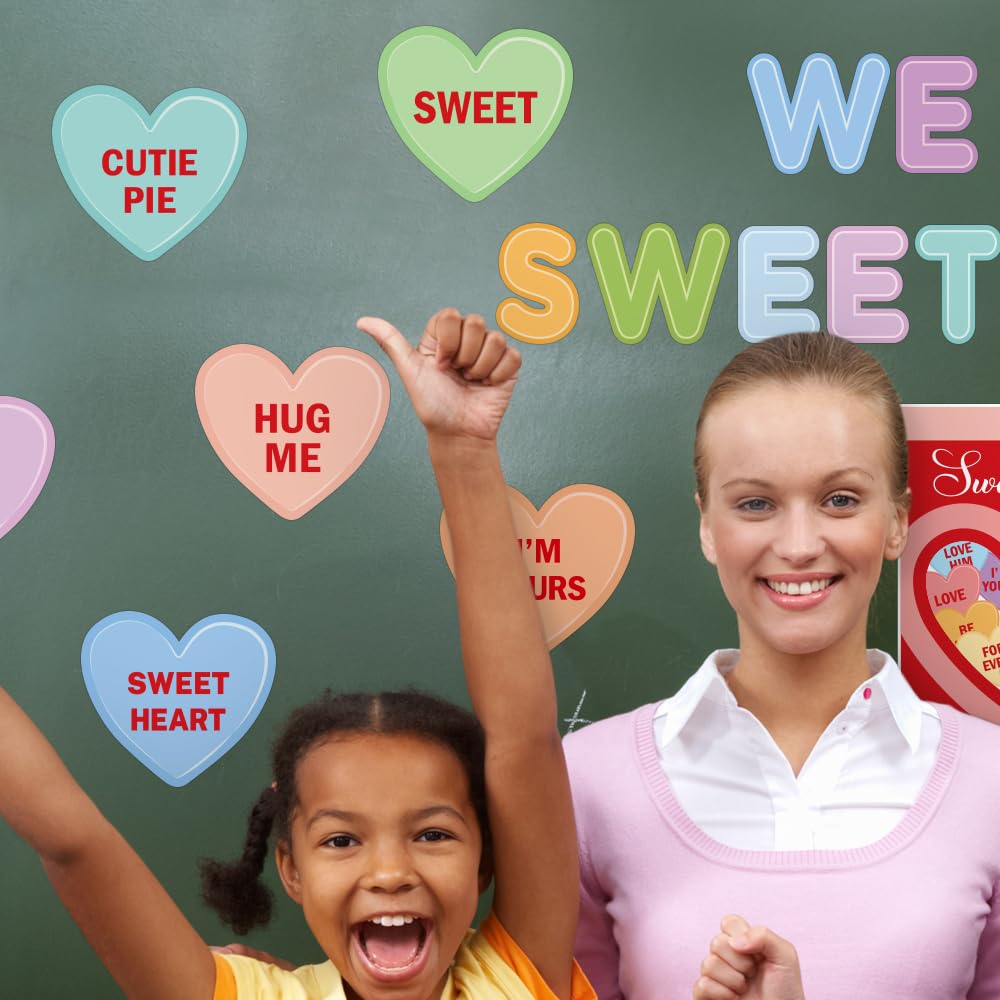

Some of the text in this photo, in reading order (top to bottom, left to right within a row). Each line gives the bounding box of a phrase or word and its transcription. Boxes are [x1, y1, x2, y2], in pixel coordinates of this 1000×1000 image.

[414, 92, 538, 124] SWEET
[747, 53, 978, 174] WE
[102, 149, 197, 176] CUTIE
[124, 187, 176, 214] PIE
[255, 403, 330, 434] HUG
[266, 443, 321, 473] ME
[943, 543, 973, 559] LOVE
[529, 575, 587, 601] URS
[934, 588, 967, 607] LOVE
[128, 671, 230, 695] SWEET
[131, 708, 226, 731] HEART
